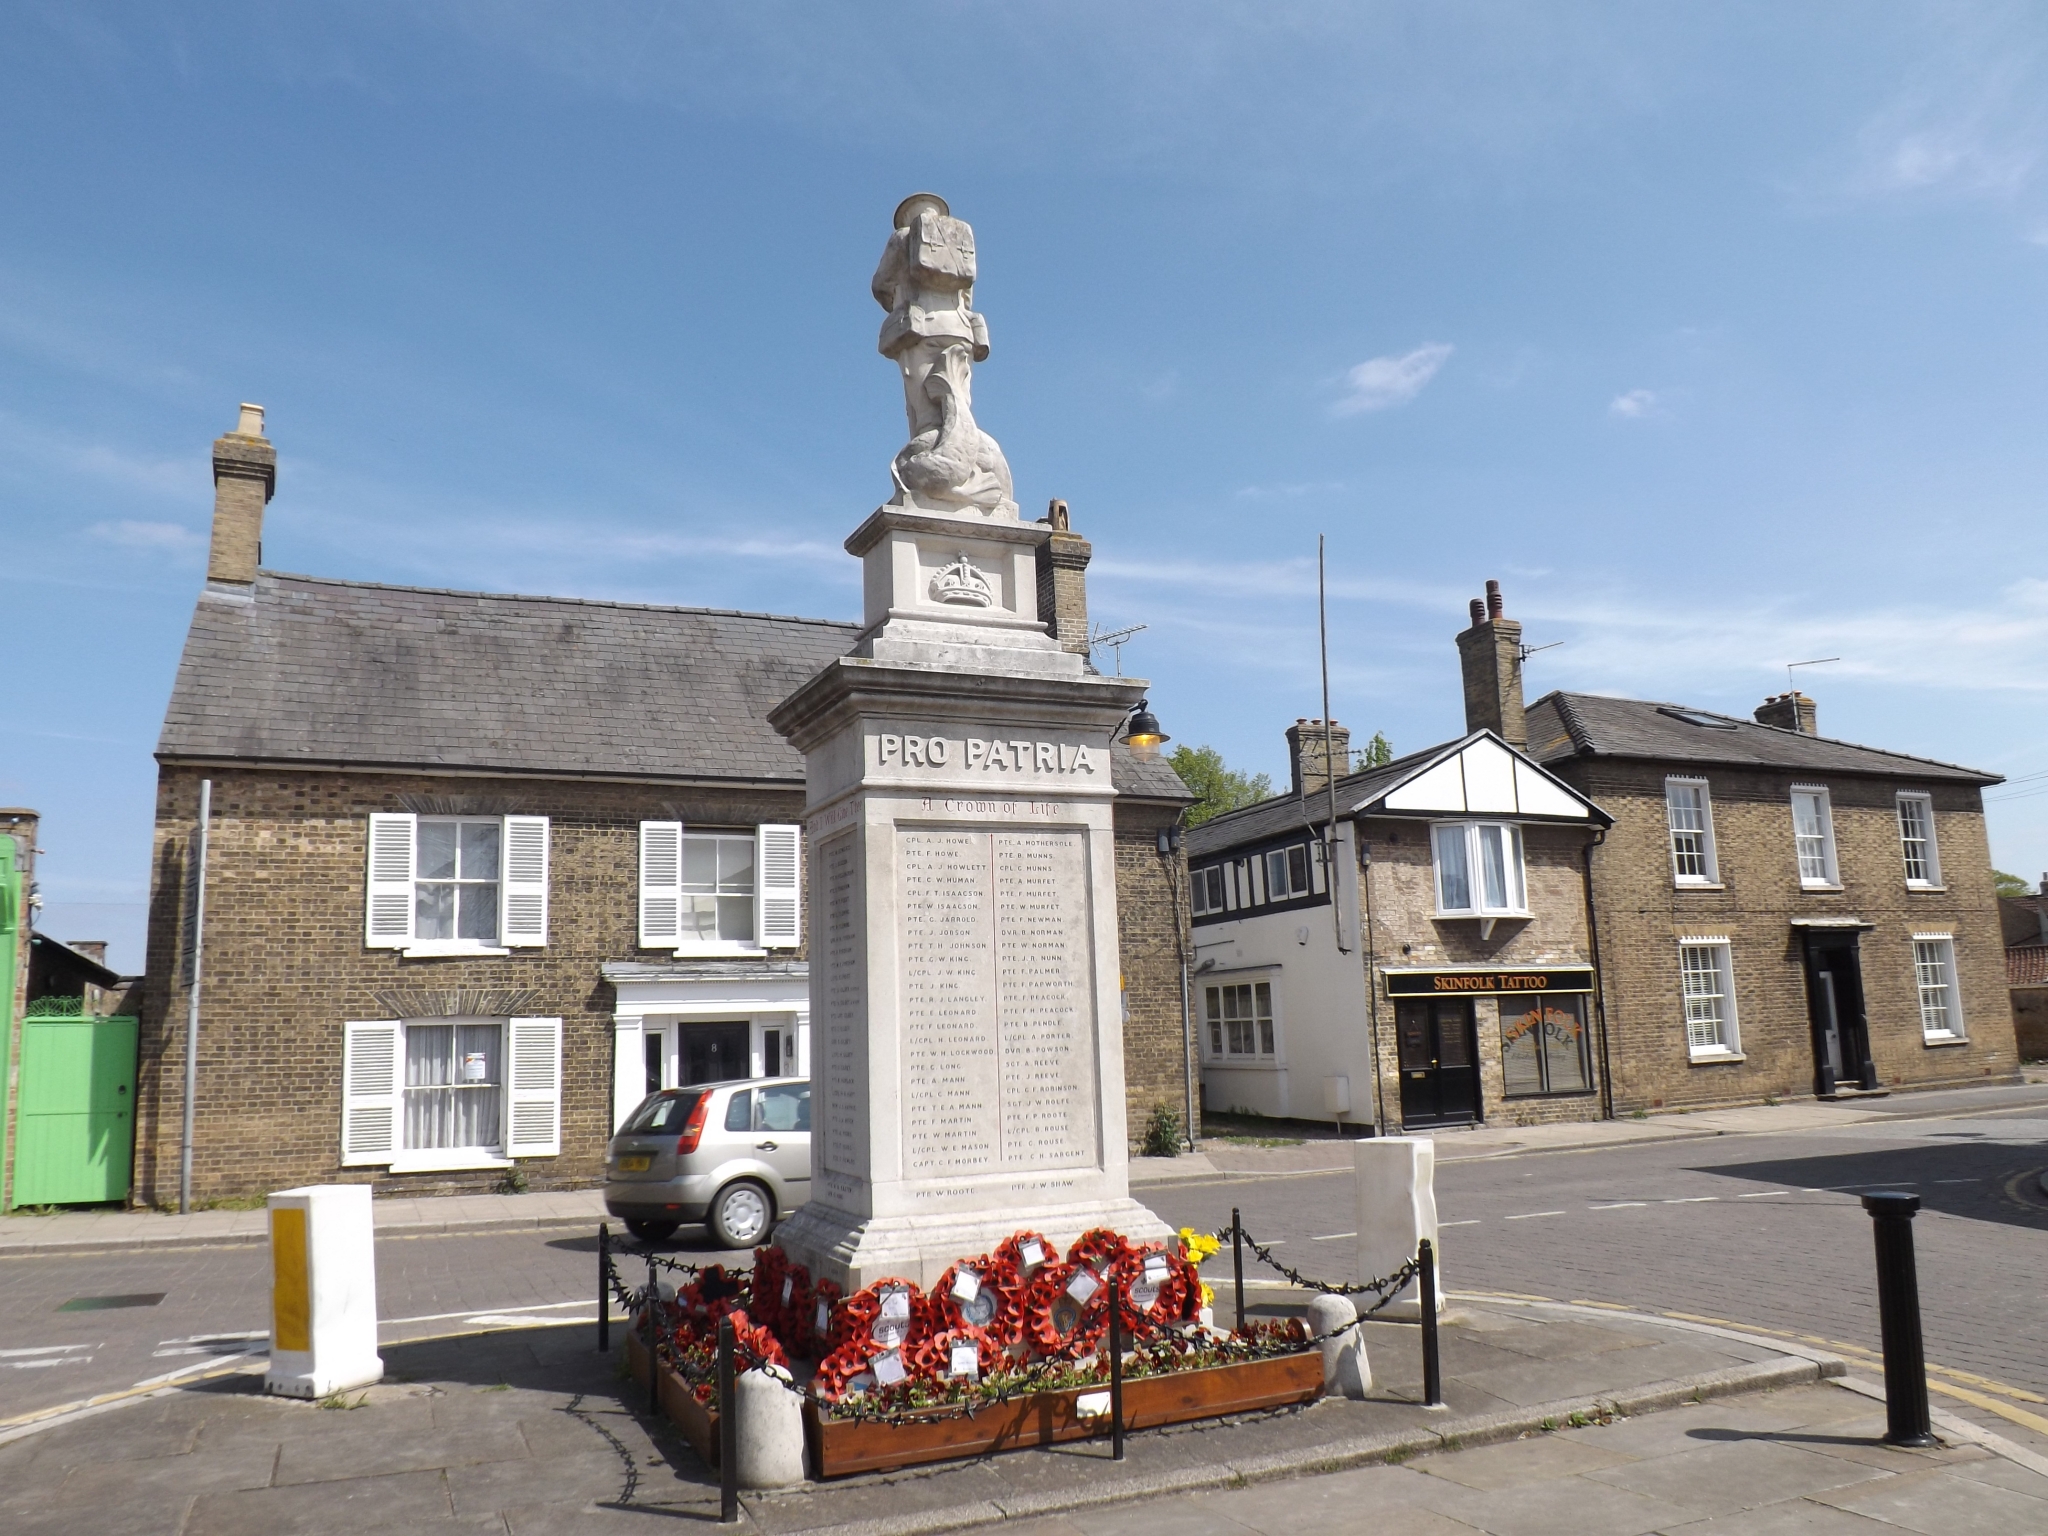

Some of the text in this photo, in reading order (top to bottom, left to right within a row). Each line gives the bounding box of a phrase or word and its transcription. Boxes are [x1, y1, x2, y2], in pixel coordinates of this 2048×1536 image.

[879, 734, 1095, 774] PRO PATRIA
[921, 797, 1060, 816] A Crown of Life
